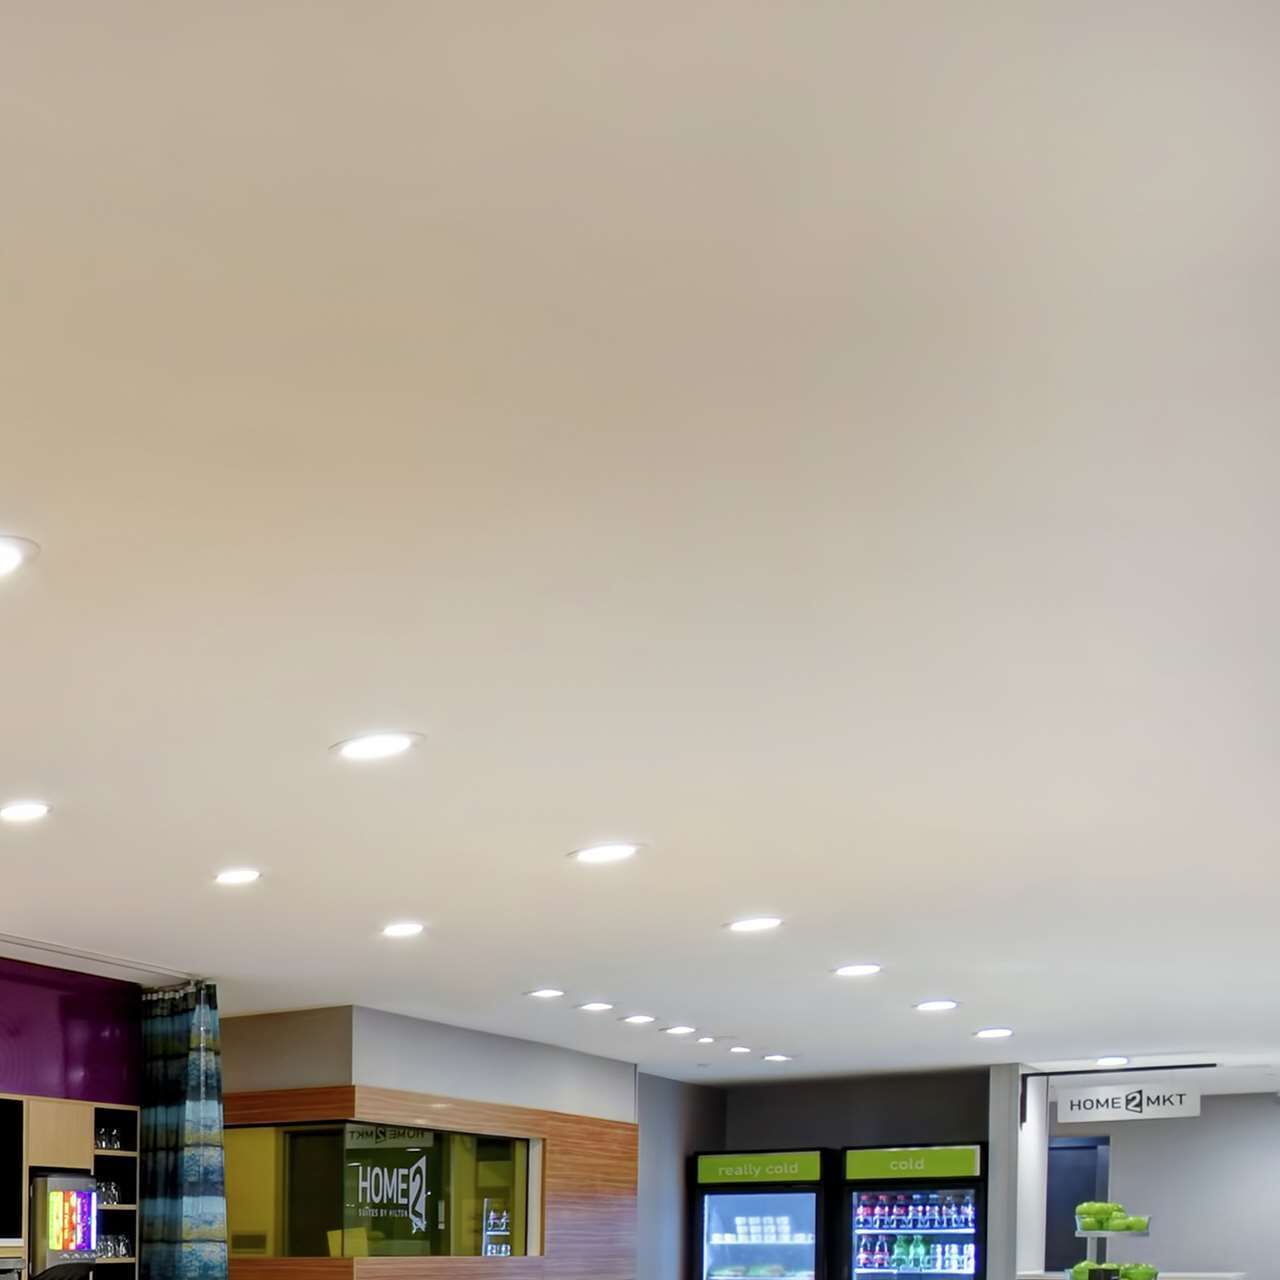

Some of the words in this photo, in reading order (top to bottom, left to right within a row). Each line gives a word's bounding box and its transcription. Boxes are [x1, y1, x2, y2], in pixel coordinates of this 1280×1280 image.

[1070, 1097, 1122, 1111] HOME
[1146, 1093, 1187, 1107] MKT
[718, 1163, 761, 1178] really
[766, 1161, 799, 1175] cold
[890, 1156, 925, 1170] cold
